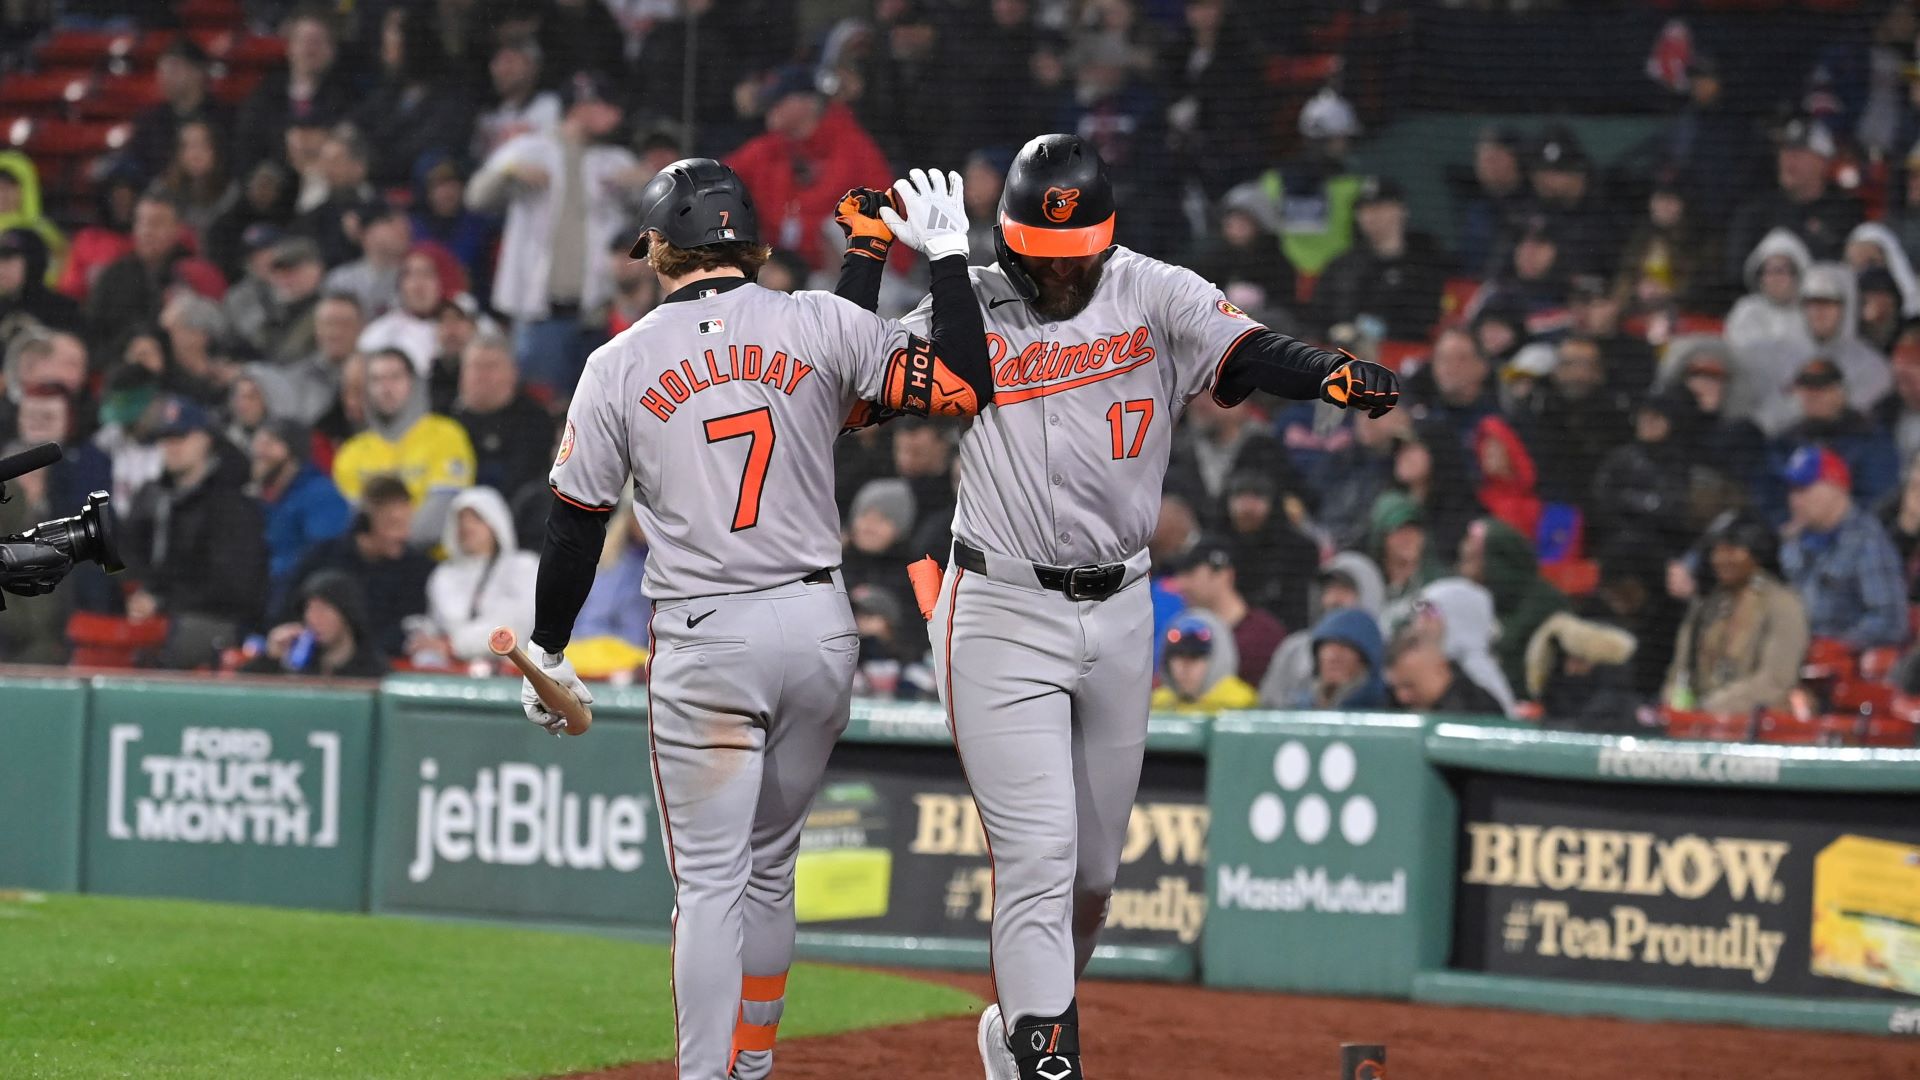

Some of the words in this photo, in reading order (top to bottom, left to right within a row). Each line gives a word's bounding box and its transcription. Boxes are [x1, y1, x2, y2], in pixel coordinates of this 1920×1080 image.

[719, 210, 729, 227] 7
[639, 344, 813, 423] HOLLIDAY
[1106, 398, 1154, 460] 17
[702, 405, 776, 533] 7
[183, 727, 271, 760] FORD
[142, 756, 304, 803] TRUCK
[136, 798, 309, 845] MONTH
[408, 757, 647, 882] jetBlue
[1217, 864, 1407, 914] MassMutual
[1503, 899, 1785, 984] #TeaProudly
